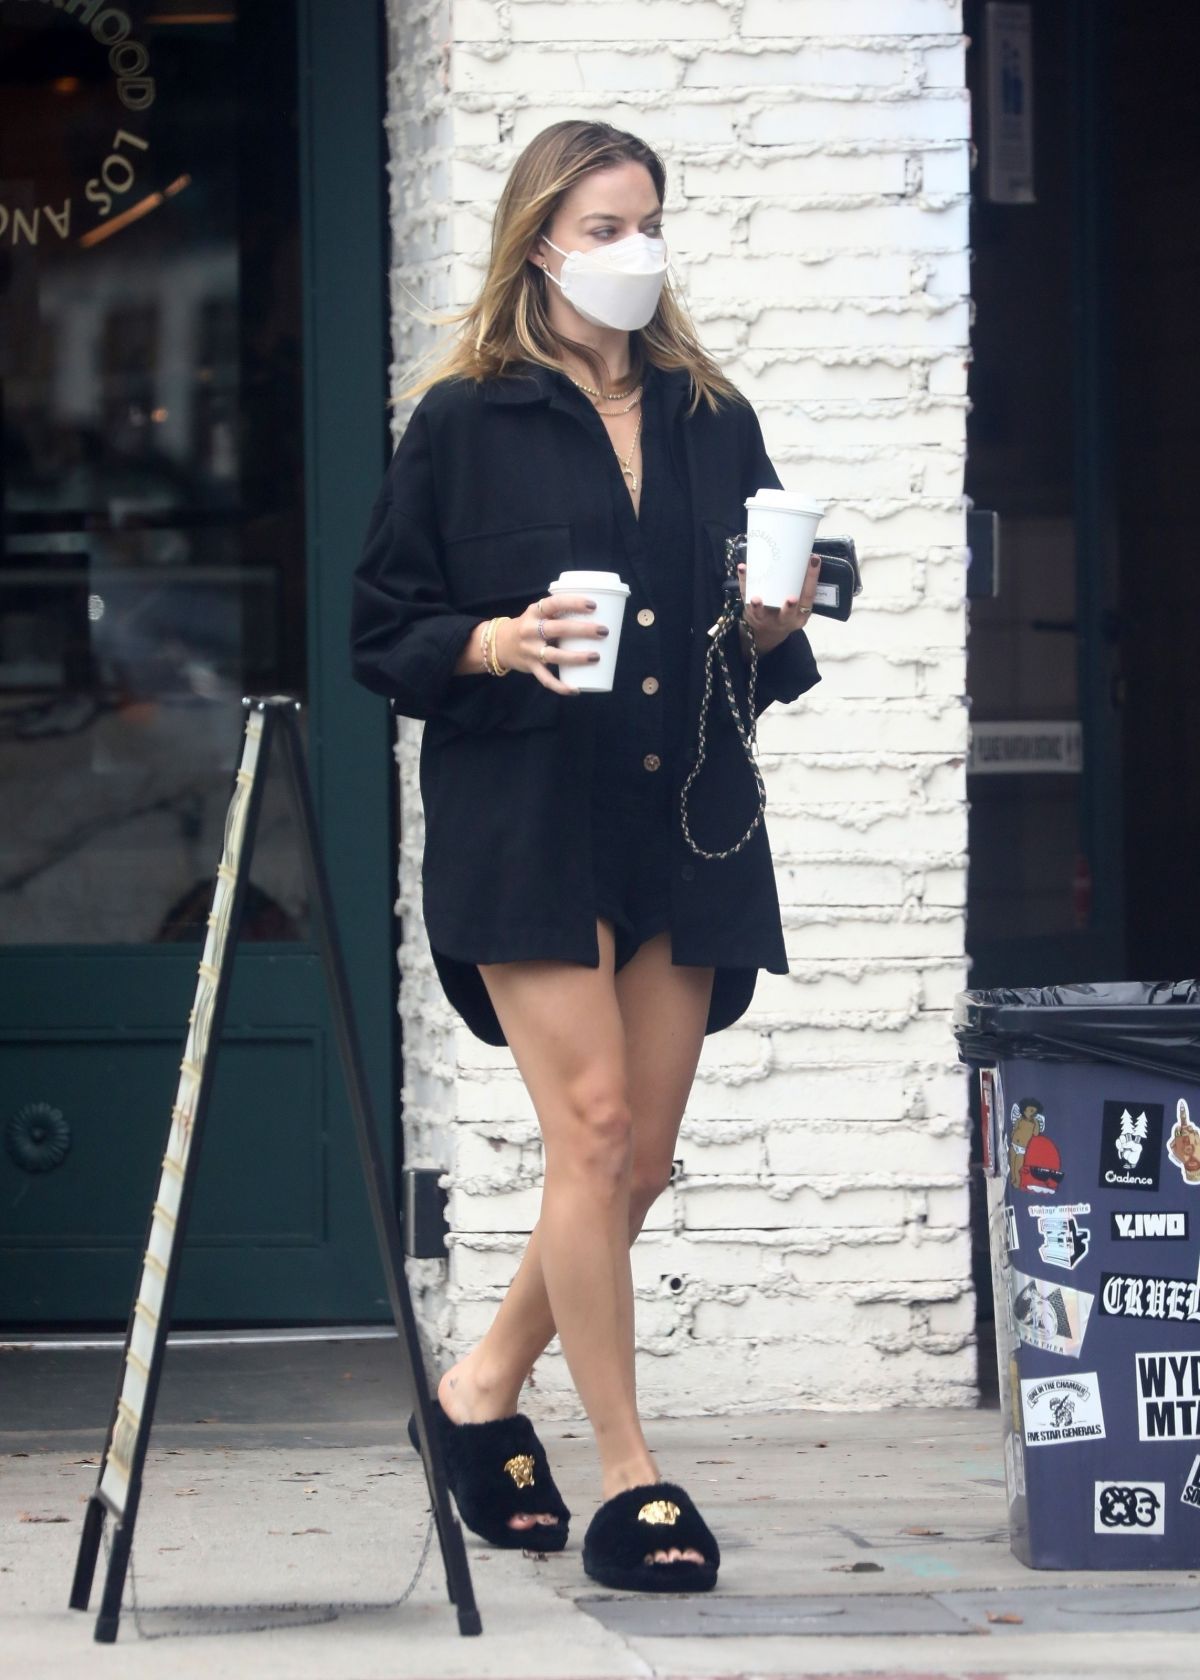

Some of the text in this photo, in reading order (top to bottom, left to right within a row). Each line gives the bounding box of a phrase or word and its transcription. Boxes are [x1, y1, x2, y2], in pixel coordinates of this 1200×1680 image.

[54, 0, 156, 111] HOOD
[84, 128, 149, 216] LOS
[1105, 1171, 1153, 1185] Cadence
[1044, 1382, 1055, 1391] THE
[1146, 1401, 1200, 1437] MT
[1040, 1430, 1061, 1441] STAR
[1062, 1425, 1102, 1438] GENERALS
